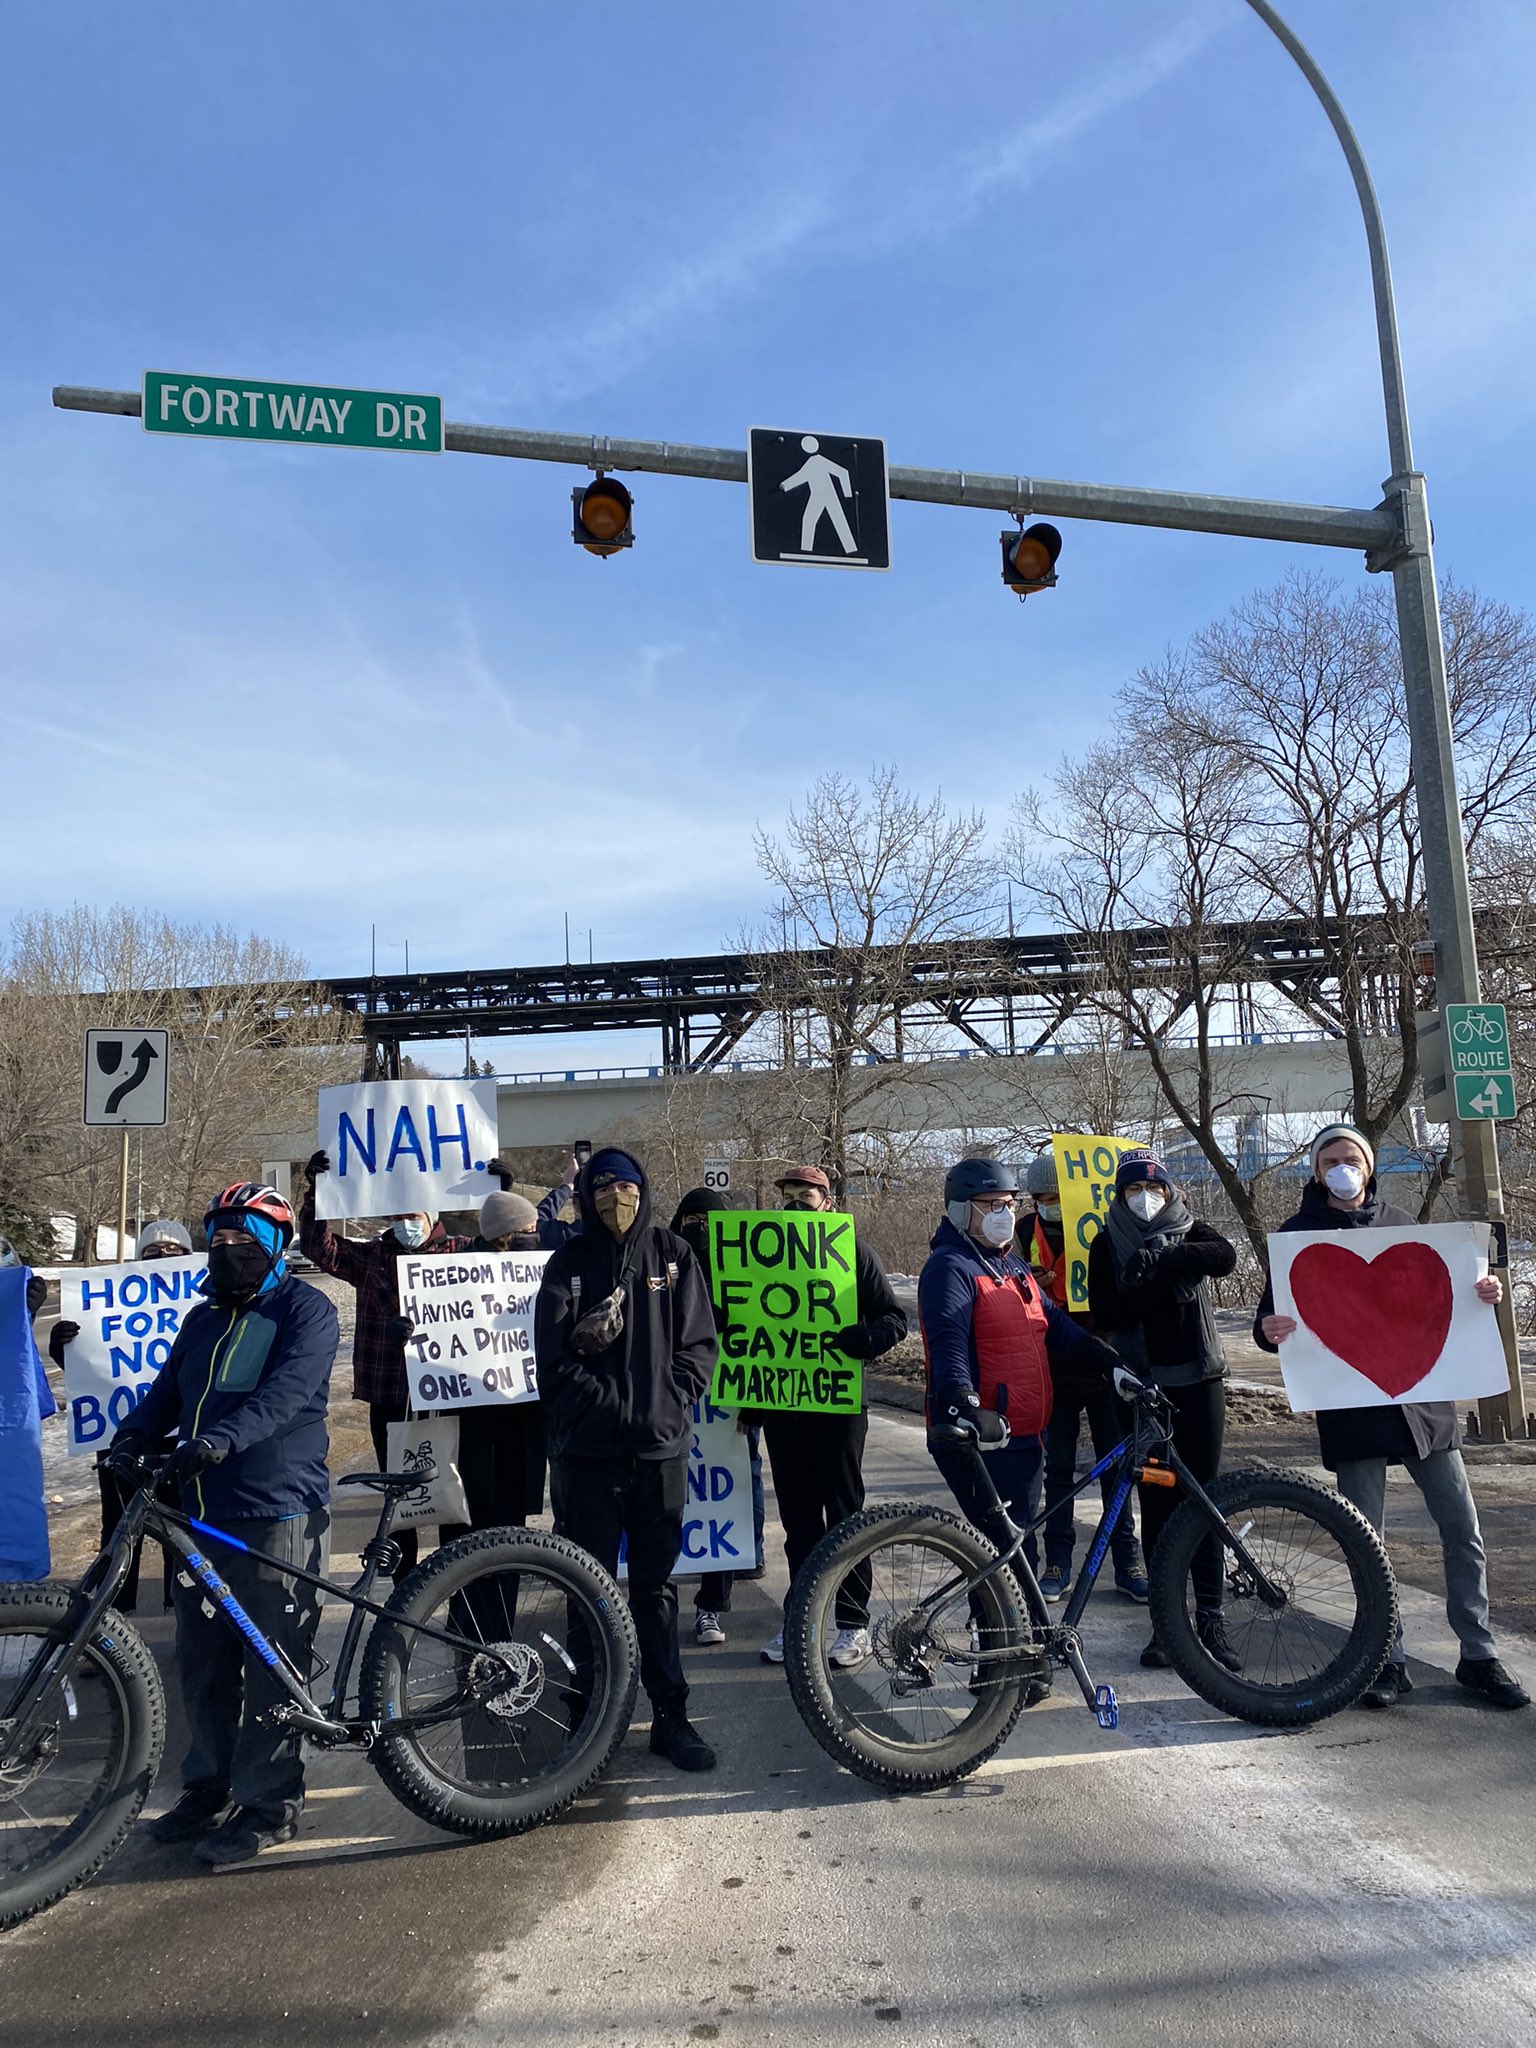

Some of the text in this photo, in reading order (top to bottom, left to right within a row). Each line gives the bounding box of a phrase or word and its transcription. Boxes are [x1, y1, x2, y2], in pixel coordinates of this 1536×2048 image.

[160, 384, 426, 440] FORTWAY DR
[1457, 1052, 1505, 1067] ROUTE
[338, 1104, 485, 1176] NAH.
[705, 1171, 729, 1187] 60
[716, 1221, 850, 1273] HONK
[81, 1268, 209, 1310] HONK
[407, 1263, 494, 1289] FREEDOM
[404, 1295, 474, 1326] HAVING
[507, 1295, 532, 1315] SAY
[720, 1280, 841, 1325] FOR
[102, 1308, 180, 1341] FOR
[451, 1334, 468, 1359] A
[474, 1328, 529, 1355] DYING
[722, 1324, 843, 1367] GAYER
[109, 1338, 172, 1378] NO
[419, 1374, 472, 1401] ONE
[483, 1366, 514, 1392] ON
[718, 1363, 854, 1408] MARRIAGE
[1088, 1535, 1109, 1577] ROCKY
[221, 1594, 279, 1665] MOUNTAIN
[97, 1633, 135, 1679] TERRENE
[416, 1771, 442, 1796] CAKE
